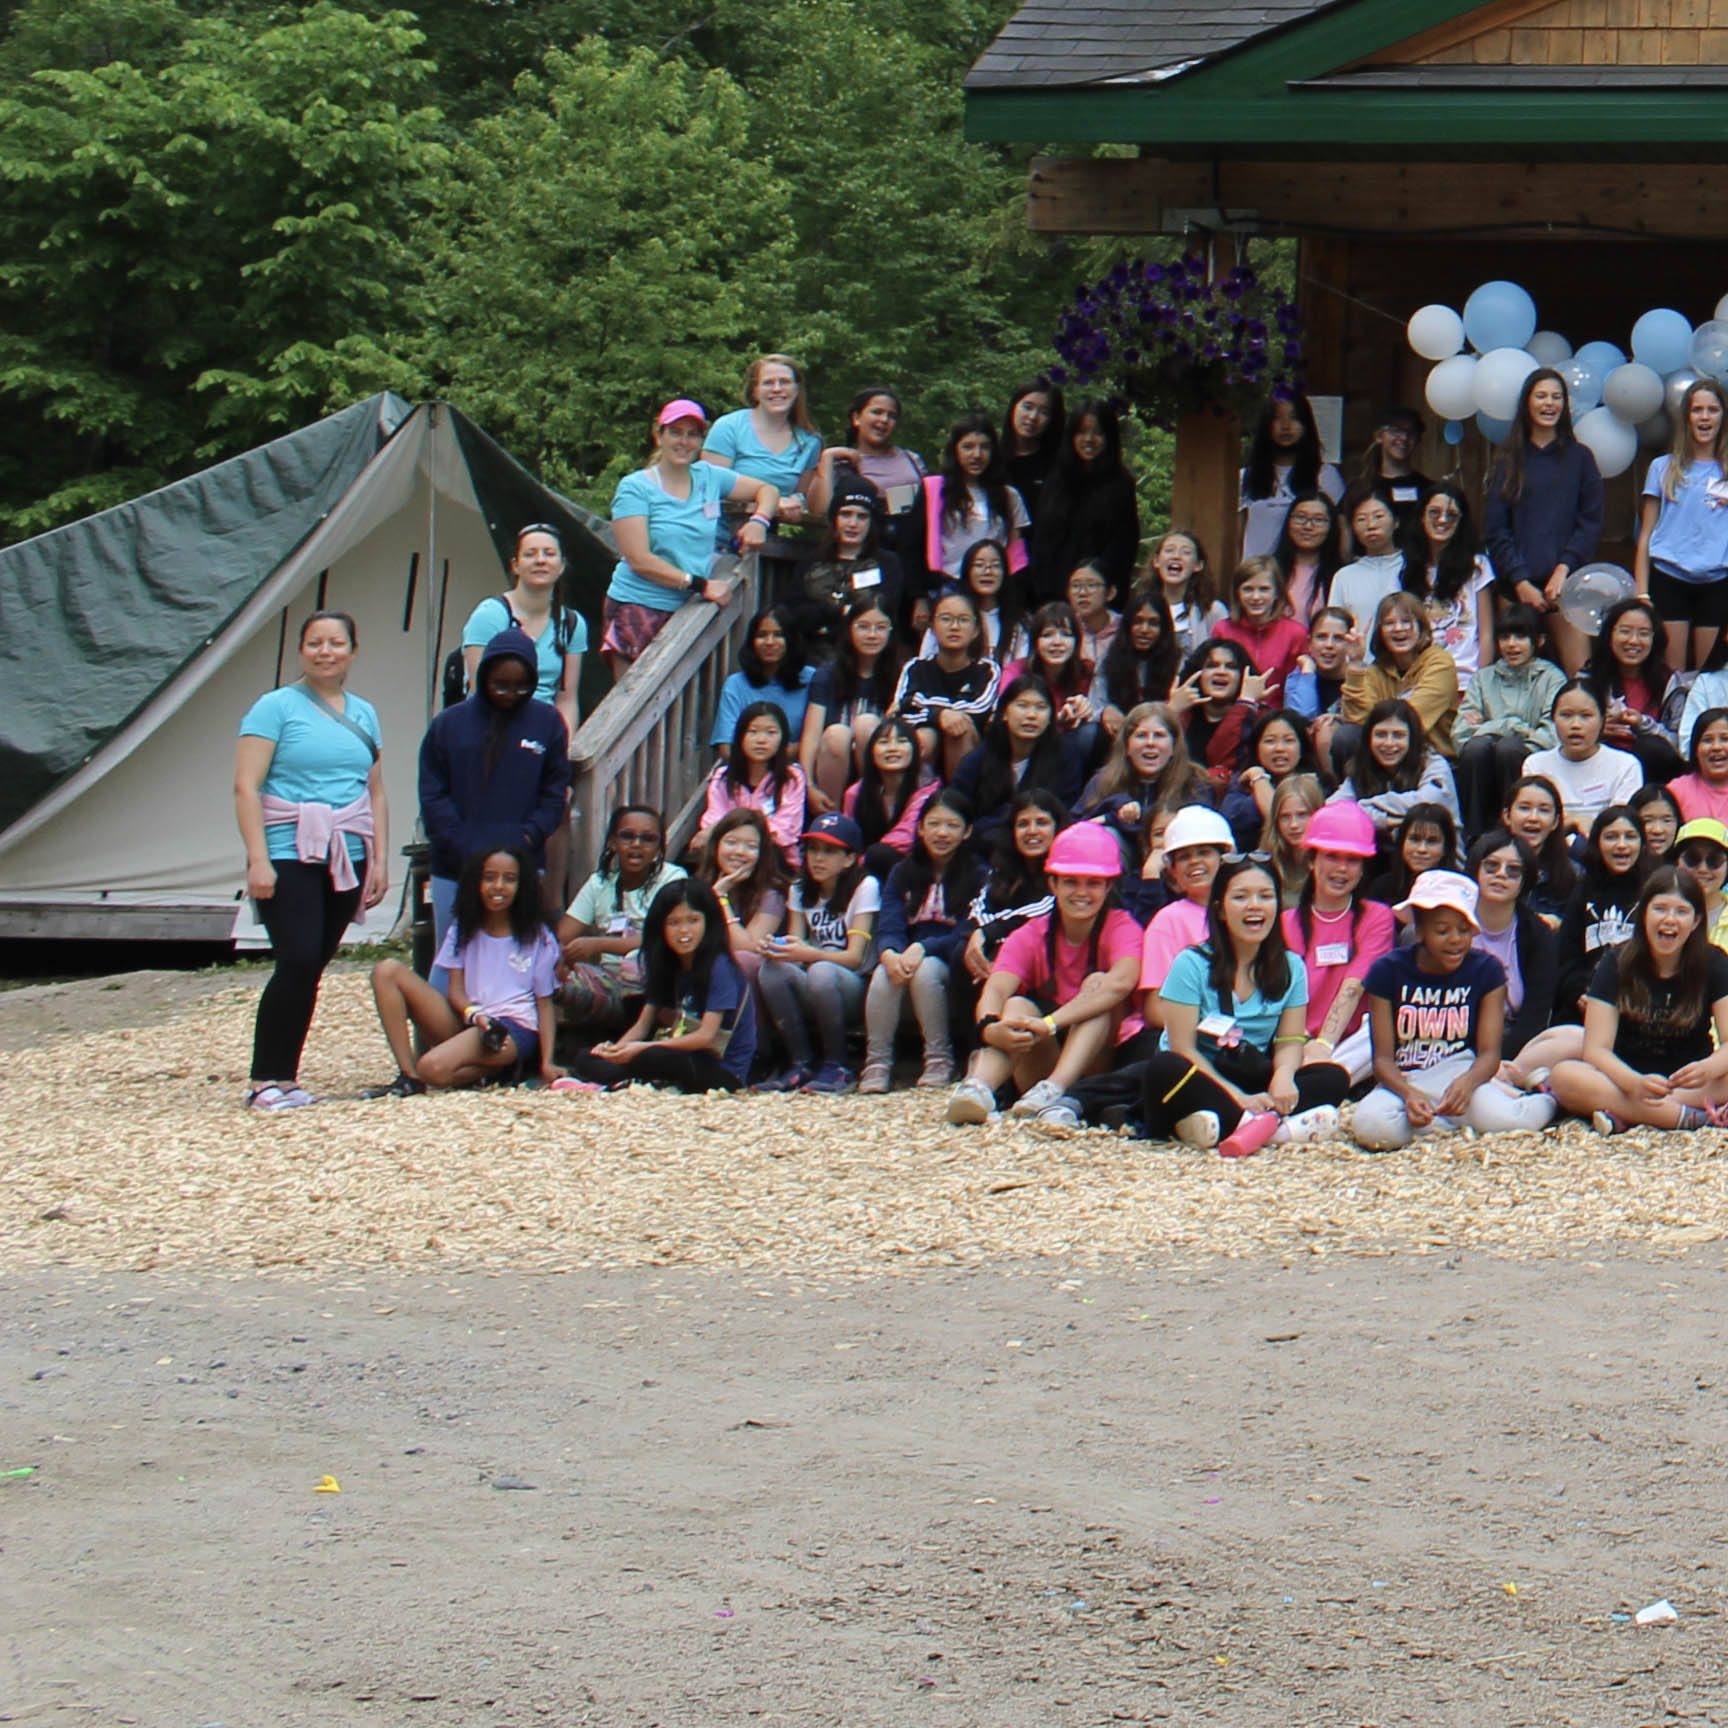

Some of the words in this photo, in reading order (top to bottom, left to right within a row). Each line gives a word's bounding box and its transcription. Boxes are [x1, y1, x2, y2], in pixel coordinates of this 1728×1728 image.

[1401, 985, 1408, 1002] I
[1410, 985, 1441, 1005] AM
[1443, 985, 1472, 1004] MY
[1396, 1004, 1470, 1041] OWN
